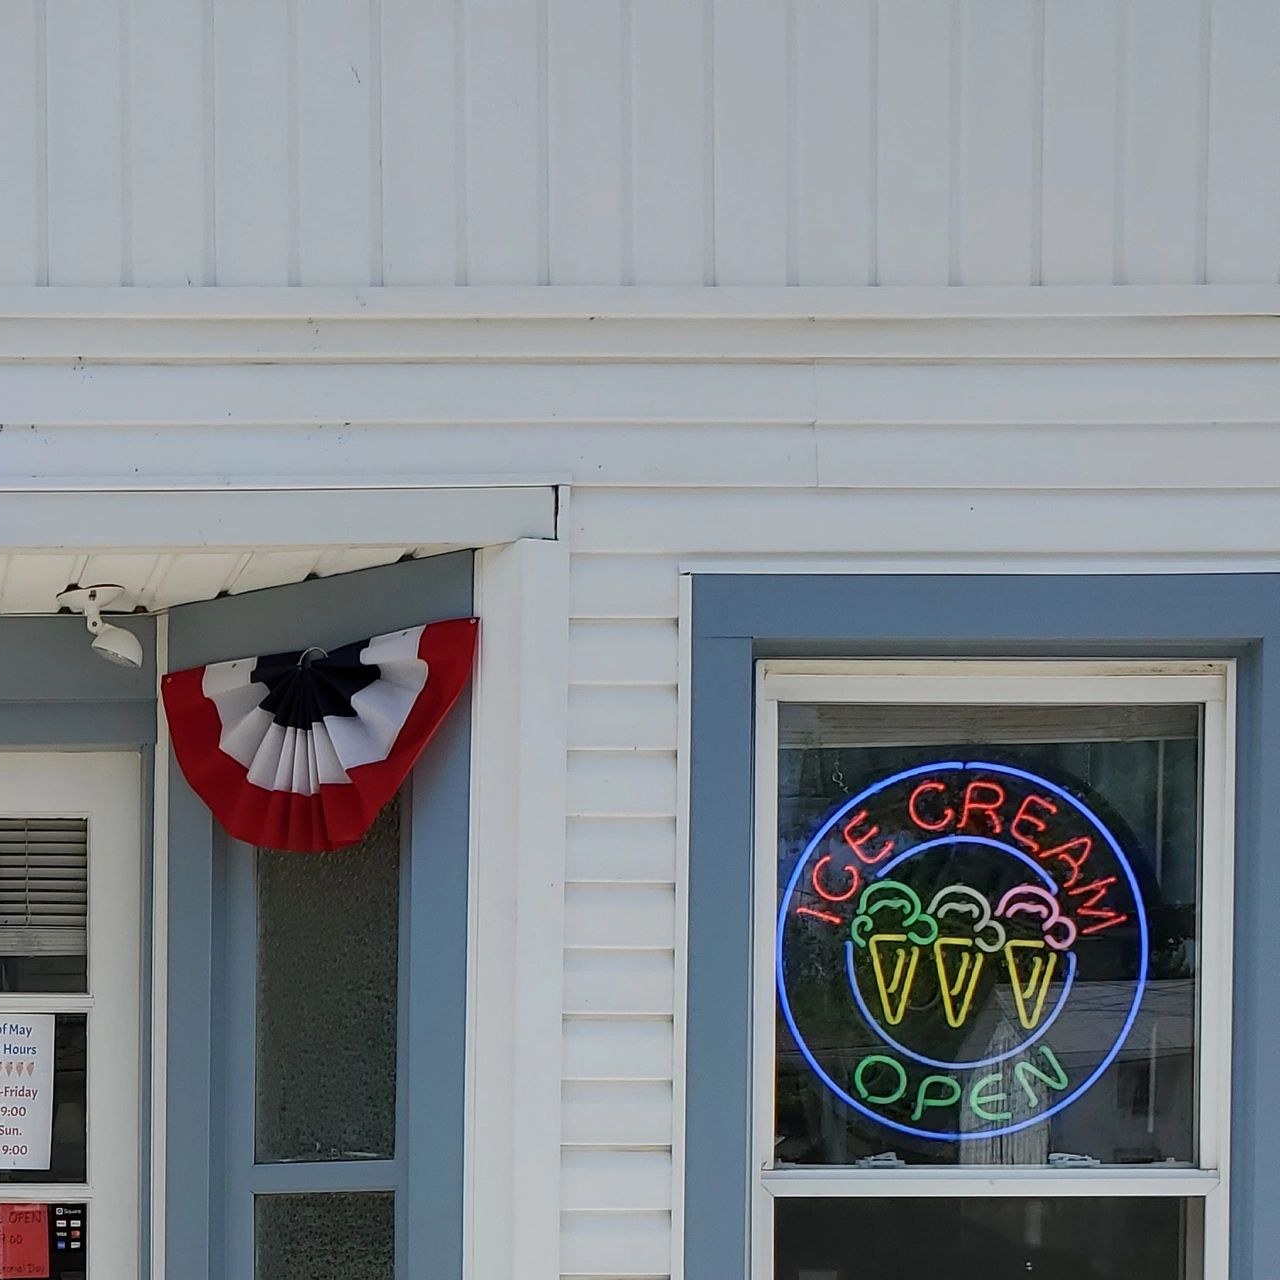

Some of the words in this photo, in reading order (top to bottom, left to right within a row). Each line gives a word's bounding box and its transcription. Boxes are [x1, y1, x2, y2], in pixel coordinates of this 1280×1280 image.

[795, 809, 895, 925] ICE
[908, 781, 1128, 935] CREAM
[10, 1024, 32, 1038] May
[3, 1044, 37, 1055] Hours
[855, 1045, 1069, 1122] OPEN
[1, 1106, 27, 1117] 9:00
[2, 1145, 28, 1156] 9:00
[9, 1210, 42, 1224] OPEN
